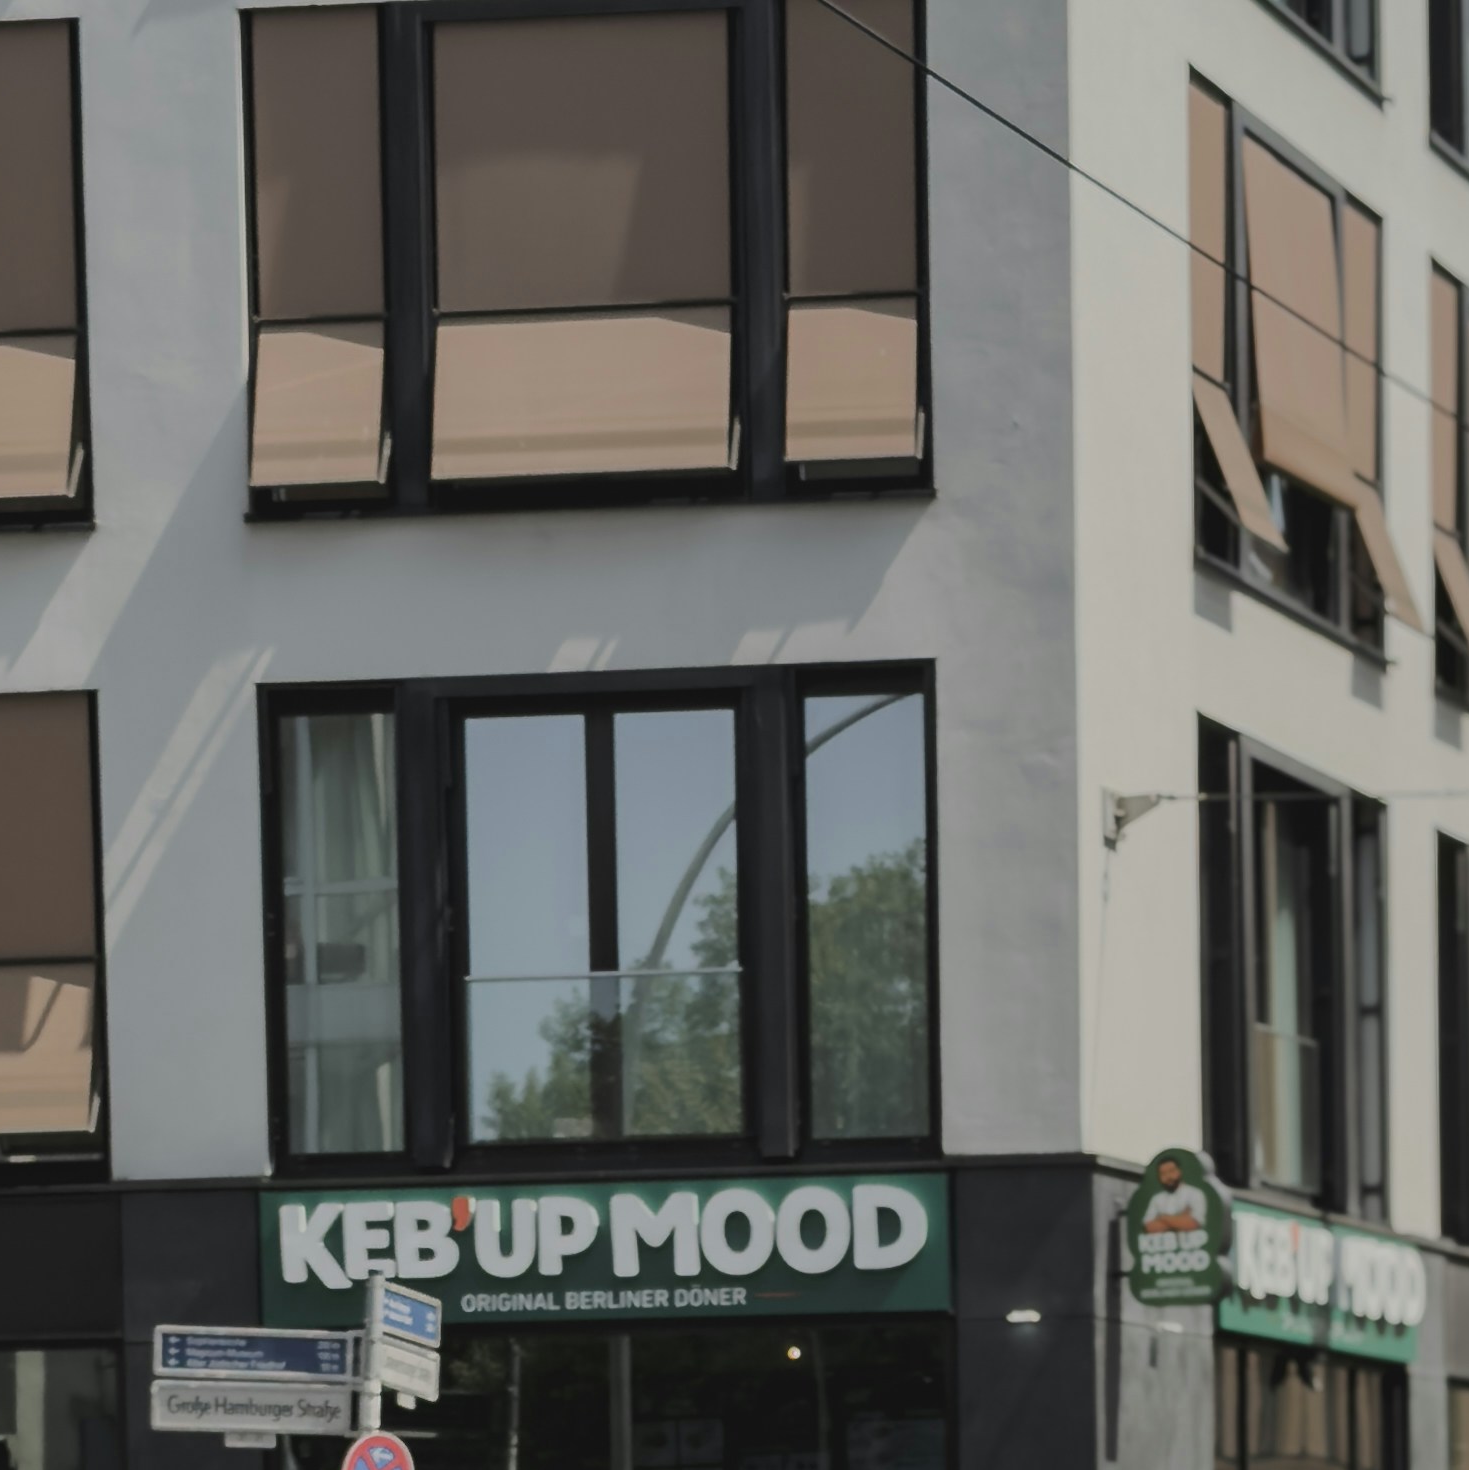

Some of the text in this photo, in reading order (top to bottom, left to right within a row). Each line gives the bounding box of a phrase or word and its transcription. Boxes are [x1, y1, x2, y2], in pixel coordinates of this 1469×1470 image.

[609, 1184, 928, 1278] MOOD
[1141, 1250, 1211, 1274] MOOD
[461, 1284, 747, 1313] ORIGINAL BERLINER DÖNER
[215, 1397, 294, 1422] Hamburger
[297, 1399, 342, 1423] Straße
